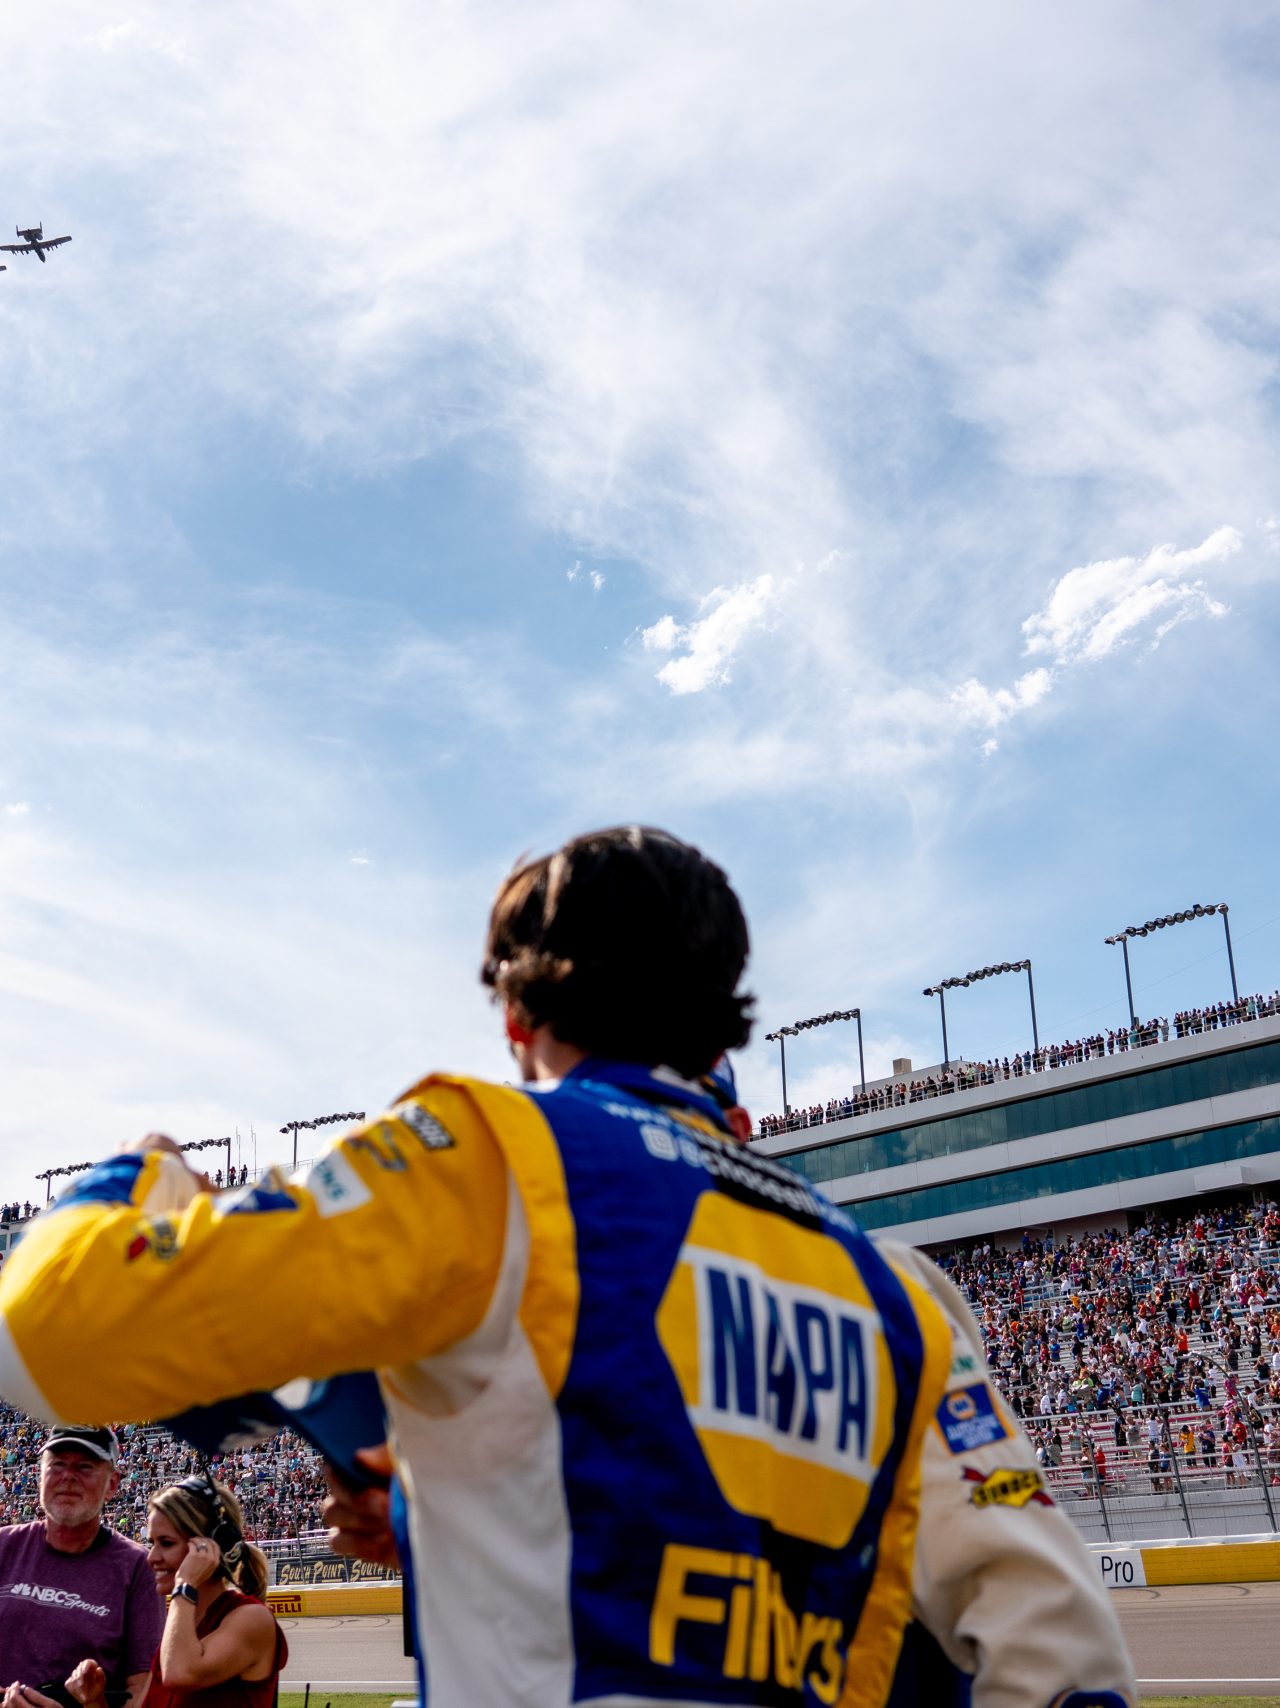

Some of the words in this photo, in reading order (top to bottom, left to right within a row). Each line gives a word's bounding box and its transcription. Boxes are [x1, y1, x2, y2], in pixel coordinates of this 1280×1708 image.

[706, 1266, 869, 1462] NAPA
[313, 1560, 345, 1585] POINT
[351, 1559, 384, 1582] SOUTH
[1101, 1555, 1134, 1584] Pro
[30, 1586, 68, 1603] NBC
[64, 1593, 111, 1617] Sports
[268, 1603, 302, 1614] RELLI
